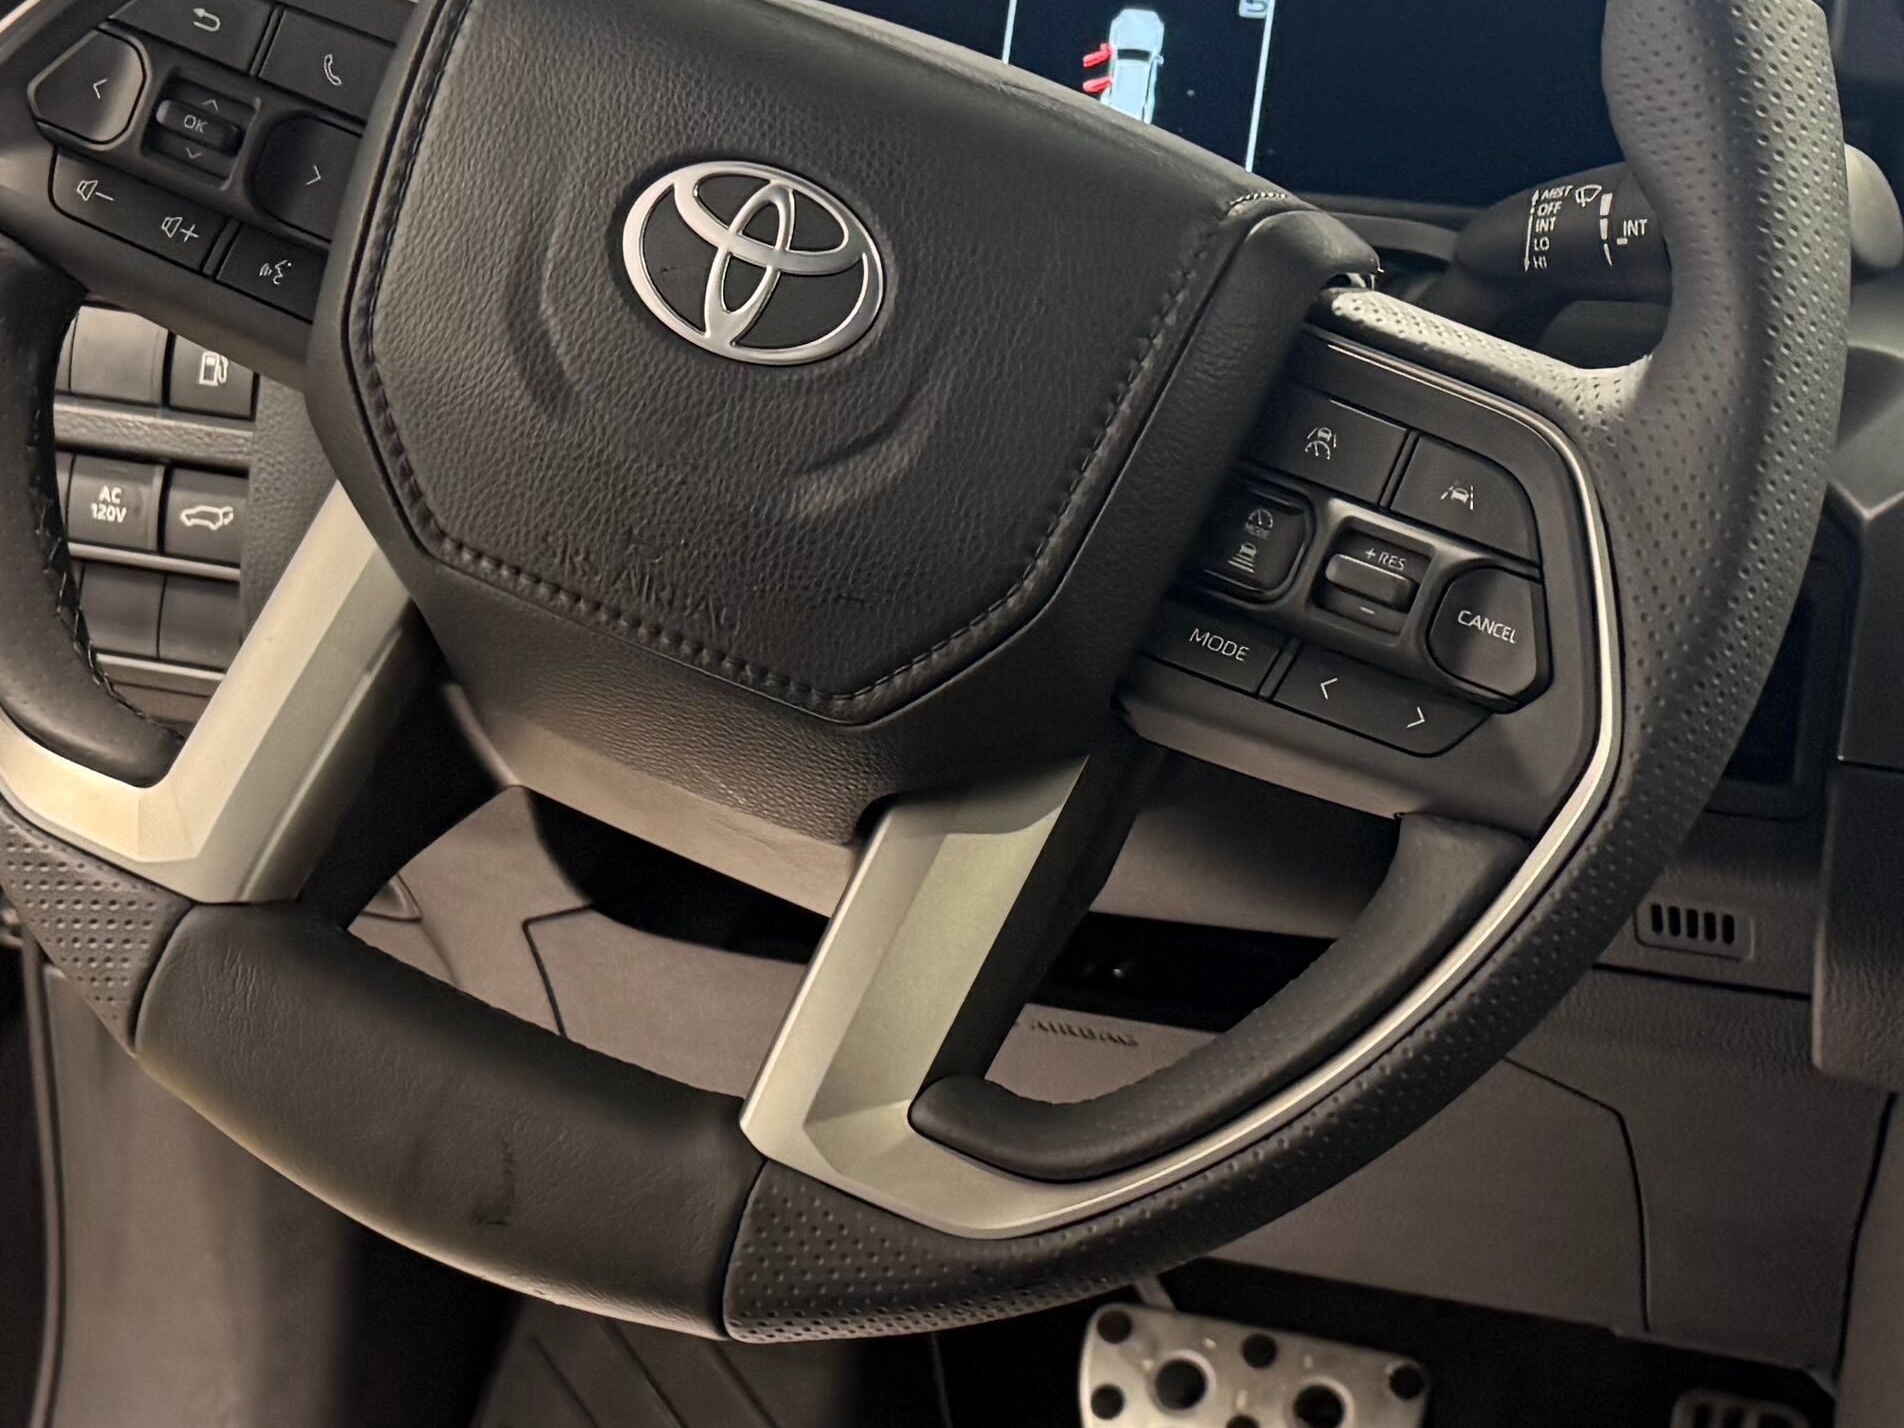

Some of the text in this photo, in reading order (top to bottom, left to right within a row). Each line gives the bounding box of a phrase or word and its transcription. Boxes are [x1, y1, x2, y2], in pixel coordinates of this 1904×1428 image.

[183, 115, 207, 134] OK
[1541, 184, 1573, 201] MIST
[1537, 200, 1563, 218] OFF
[1535, 217, 1556, 234] INT
[1622, 219, 1648, 237] INT
[1533, 236, 1550, 252] LO
[1532, 255, 1548, 269] HI
[99, 484, 123, 504] AC
[91, 501, 127, 523] 120V
[1378, 550, 1408, 571] RES
[1457, 609, 1517, 645] CANCEL
[1189, 627, 1251, 662] MODE
